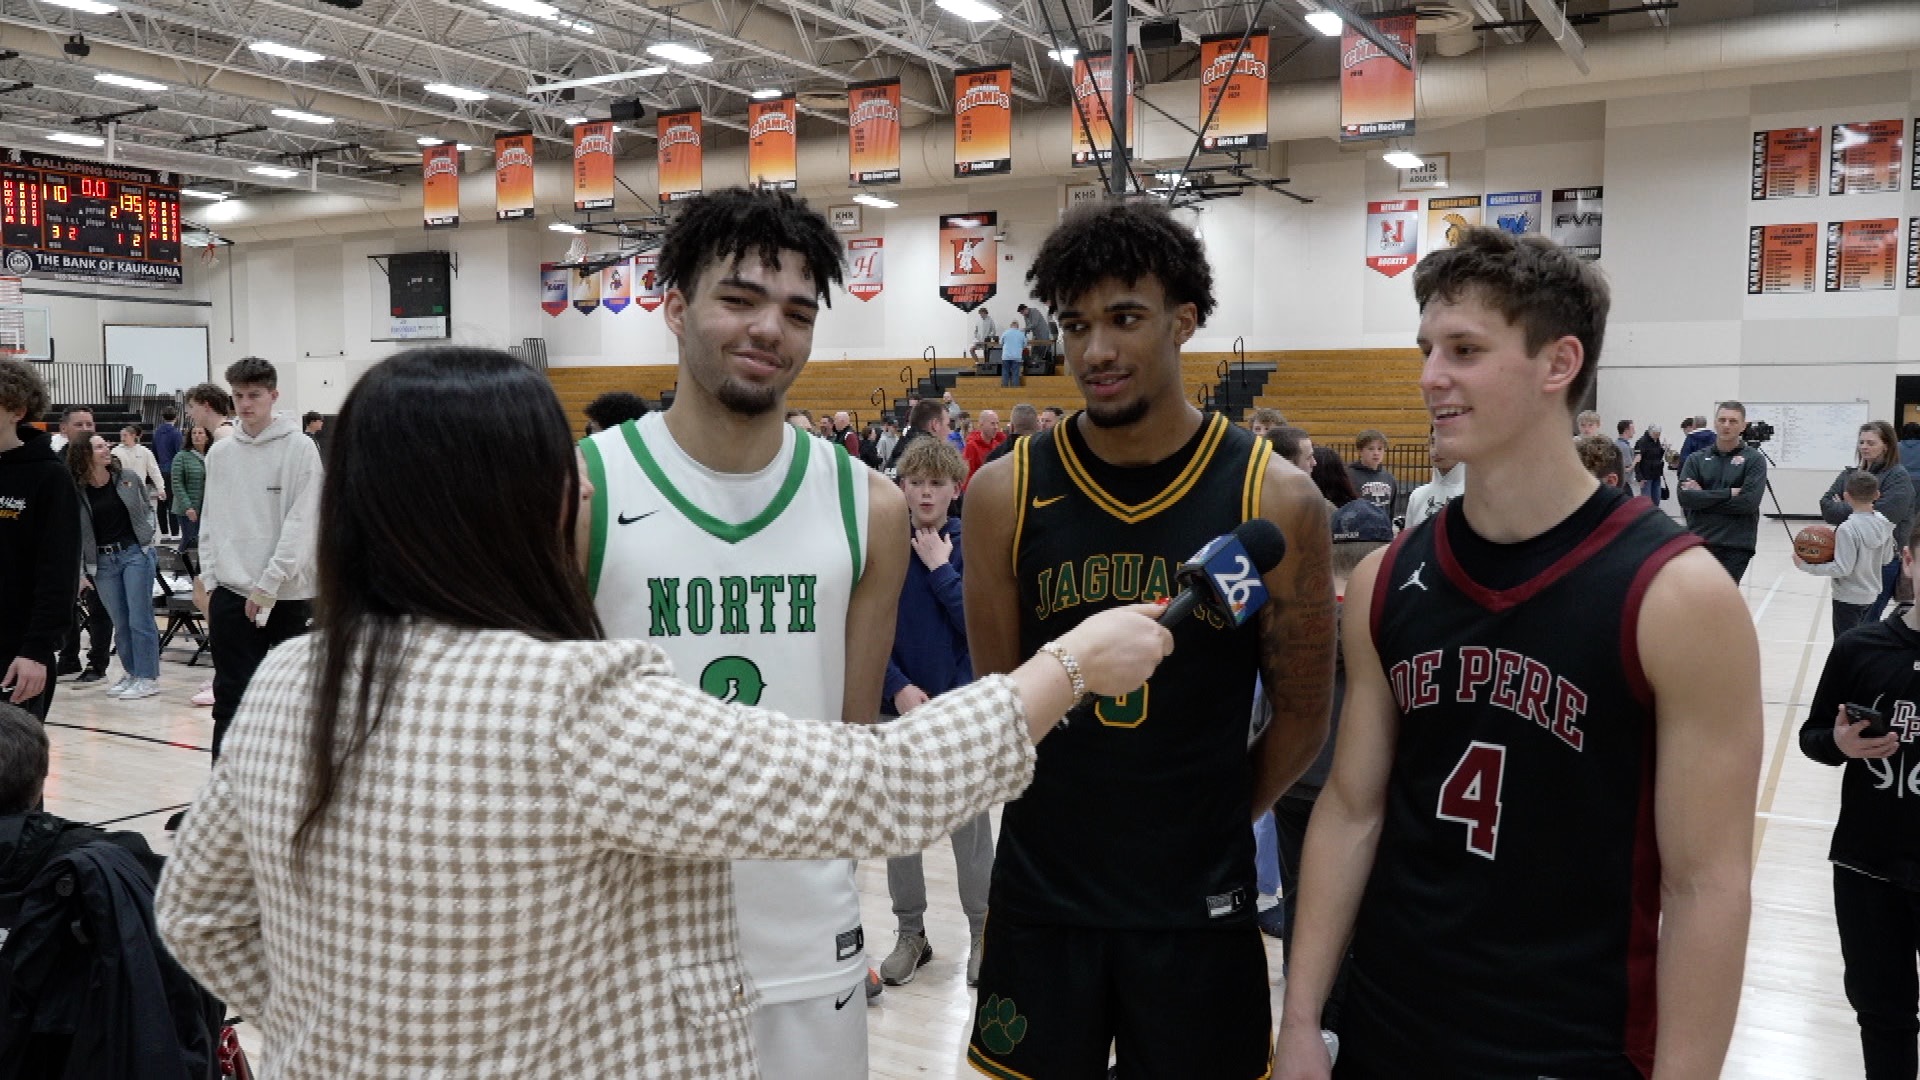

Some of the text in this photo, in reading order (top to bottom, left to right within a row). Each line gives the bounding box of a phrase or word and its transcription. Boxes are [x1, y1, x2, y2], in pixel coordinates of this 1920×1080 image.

[957, 91, 1009, 114] CHAMPS
[1378, 122, 1406, 131] Hockey
[32, 158, 103, 176] GALLOPING
[105, 168, 151, 183] GHOSTS
[1410, 174, 1437, 182] ADULTS
[120, 194, 142, 213] 135
[1075, 191, 1096, 199] KHS
[1520, 194, 1537, 202] WEST
[1555, 213, 1602, 228] FVA
[36, 254, 180, 277] THE BANK OF KAUKAUNA
[947, 285, 989, 295] GALLOPING
[1213, 556, 1262, 605] 26
[647, 574, 817, 637] NORTH
[1456, 645, 1588, 752] PERE
[1436, 740, 1506, 860] 4
